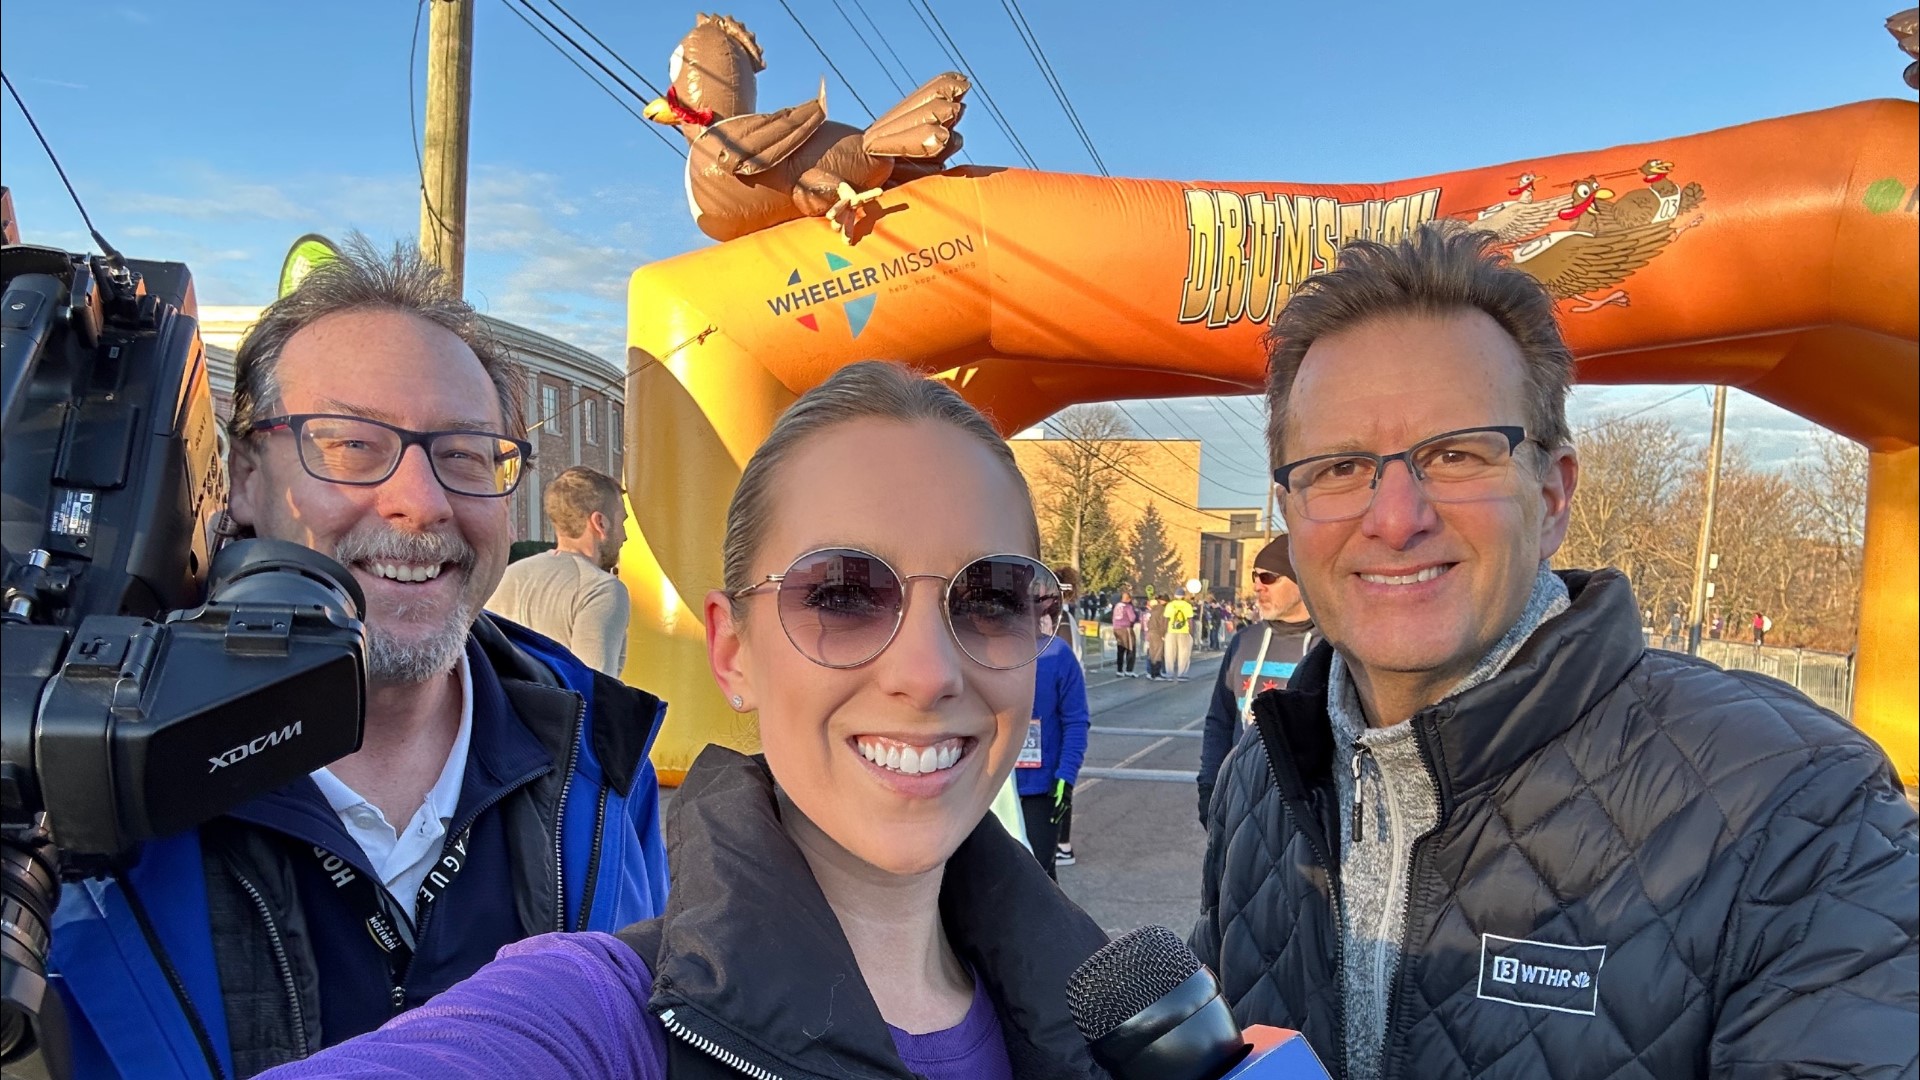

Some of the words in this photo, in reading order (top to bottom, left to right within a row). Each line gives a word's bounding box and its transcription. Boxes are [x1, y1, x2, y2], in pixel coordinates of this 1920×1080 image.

[1660, 199, 1678, 218] 03
[767, 267, 880, 316] WHEELER
[881, 234, 974, 281] MISSION
[208, 720, 302, 774] XDCAM
[369, 916, 397, 950] HORIZON
[1495, 957, 1517, 982] 13
[1521, 963, 1572, 988] WTHR
